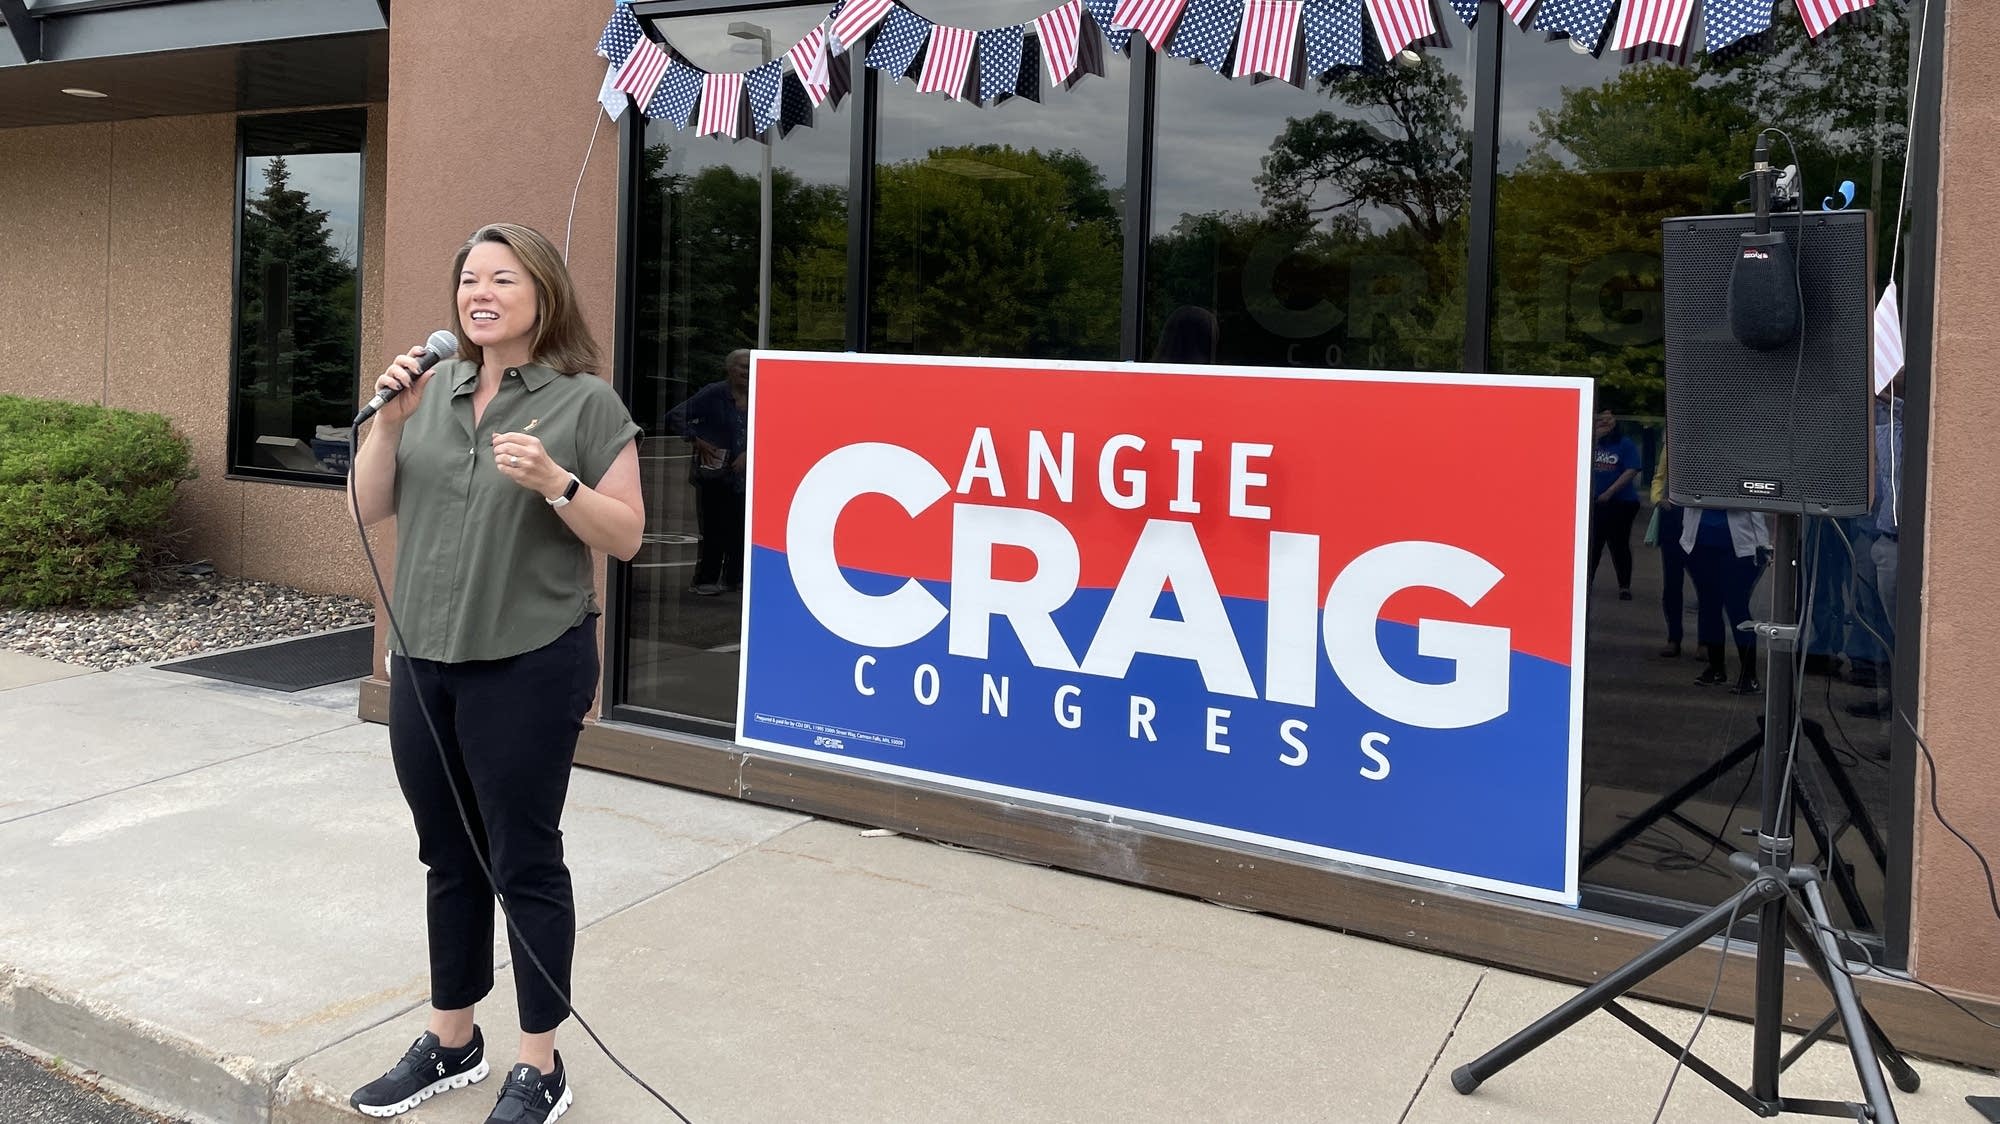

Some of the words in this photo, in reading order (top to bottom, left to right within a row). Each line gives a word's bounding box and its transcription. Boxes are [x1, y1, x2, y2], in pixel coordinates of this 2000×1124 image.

[956, 427, 1274, 520] ANGIE
[1743, 482, 1775, 490] QSC
[786, 441, 1511, 729] CRAIG
[854, 654, 1391, 781] CONGRESS
